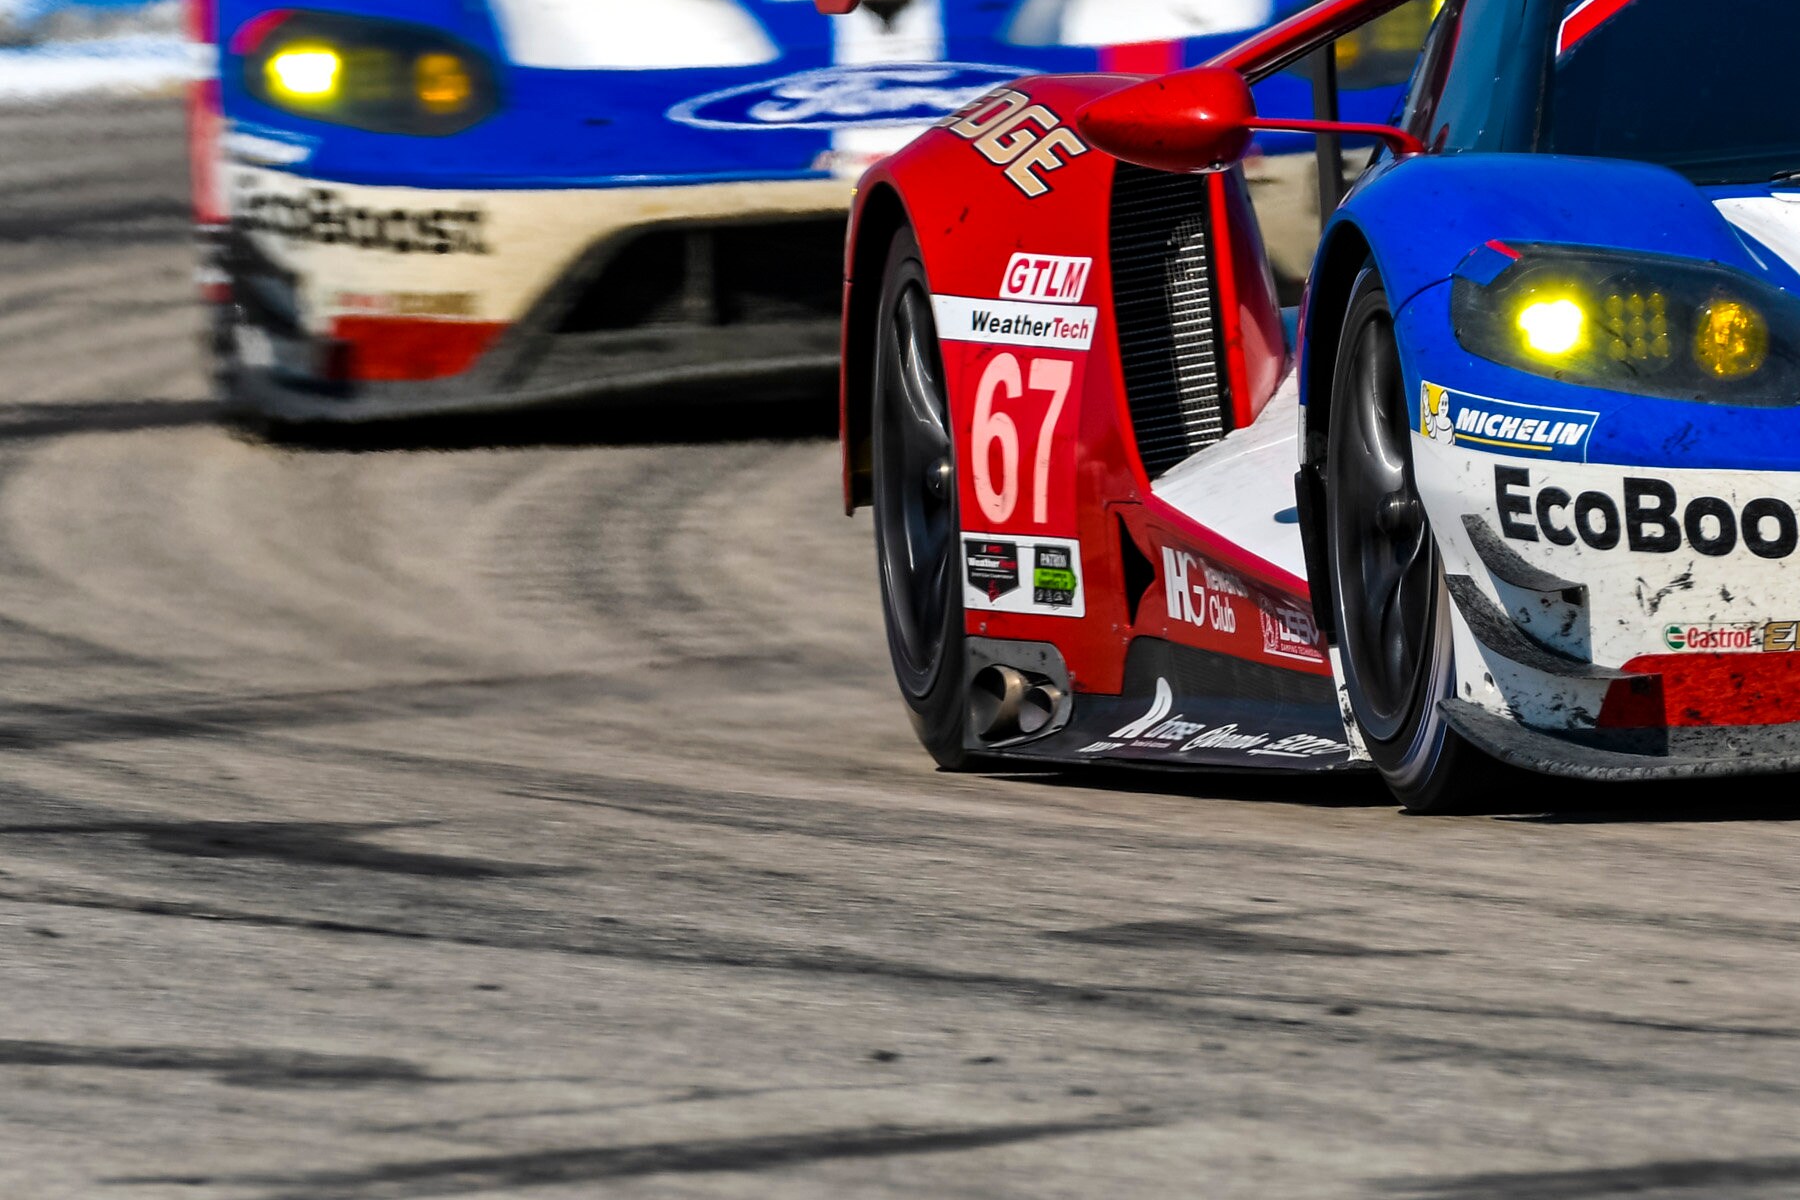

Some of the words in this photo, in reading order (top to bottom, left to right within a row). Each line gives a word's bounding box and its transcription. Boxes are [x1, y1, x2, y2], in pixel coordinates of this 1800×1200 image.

[1007, 258, 1086, 298] GTLM
[972, 310, 1090, 339] WeatherTech
[970, 352, 1074, 525] 67
[1455, 407, 1589, 447] MICHELIN
[1161, 546, 1206, 627] IHG
[1208, 595, 1236, 634] Club
[1687, 627, 1753, 649] Castrol
